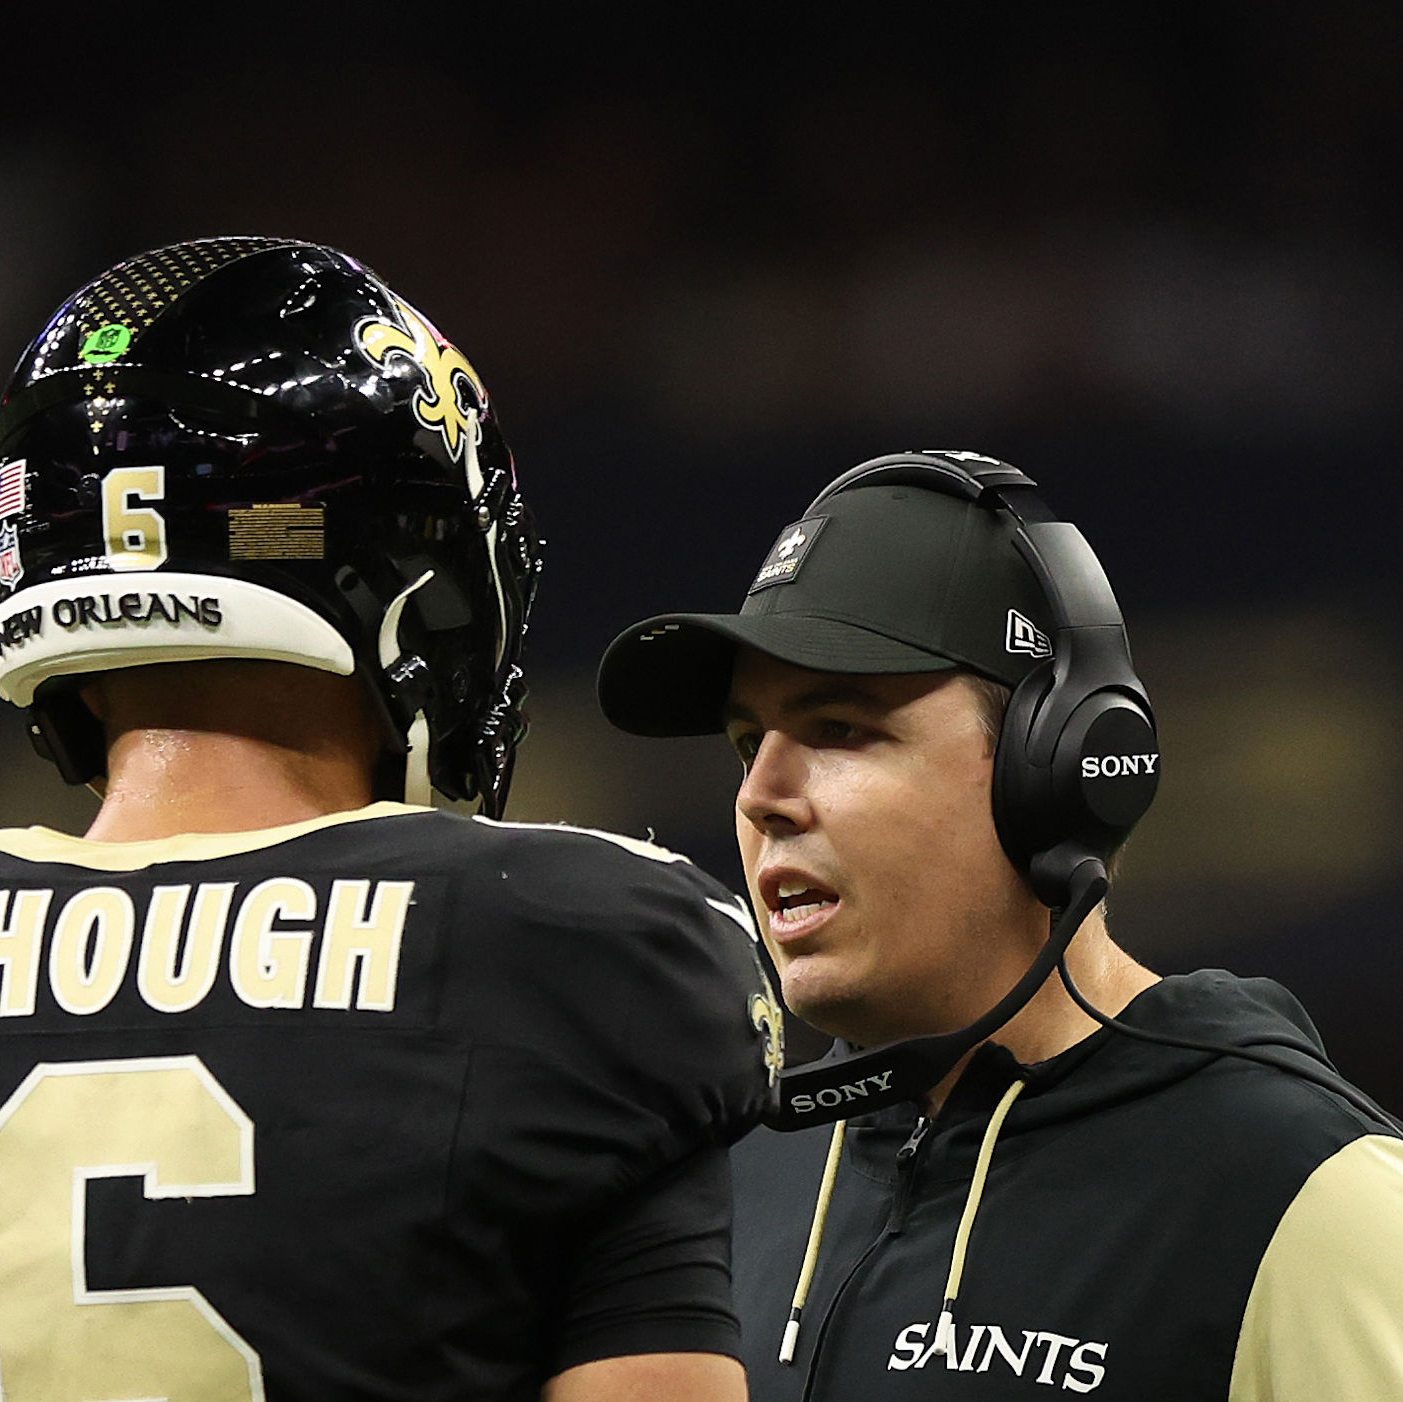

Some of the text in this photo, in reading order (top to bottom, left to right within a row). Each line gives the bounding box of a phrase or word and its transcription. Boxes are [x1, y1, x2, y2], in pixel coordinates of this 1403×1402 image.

[101, 465, 168, 571] 6
[52, 592, 223, 628] ORLEANS
[1081, 754, 1159, 778] SONY
[790, 1069, 893, 1114] SONY
[887, 1322, 1109, 1394] SAINTS
